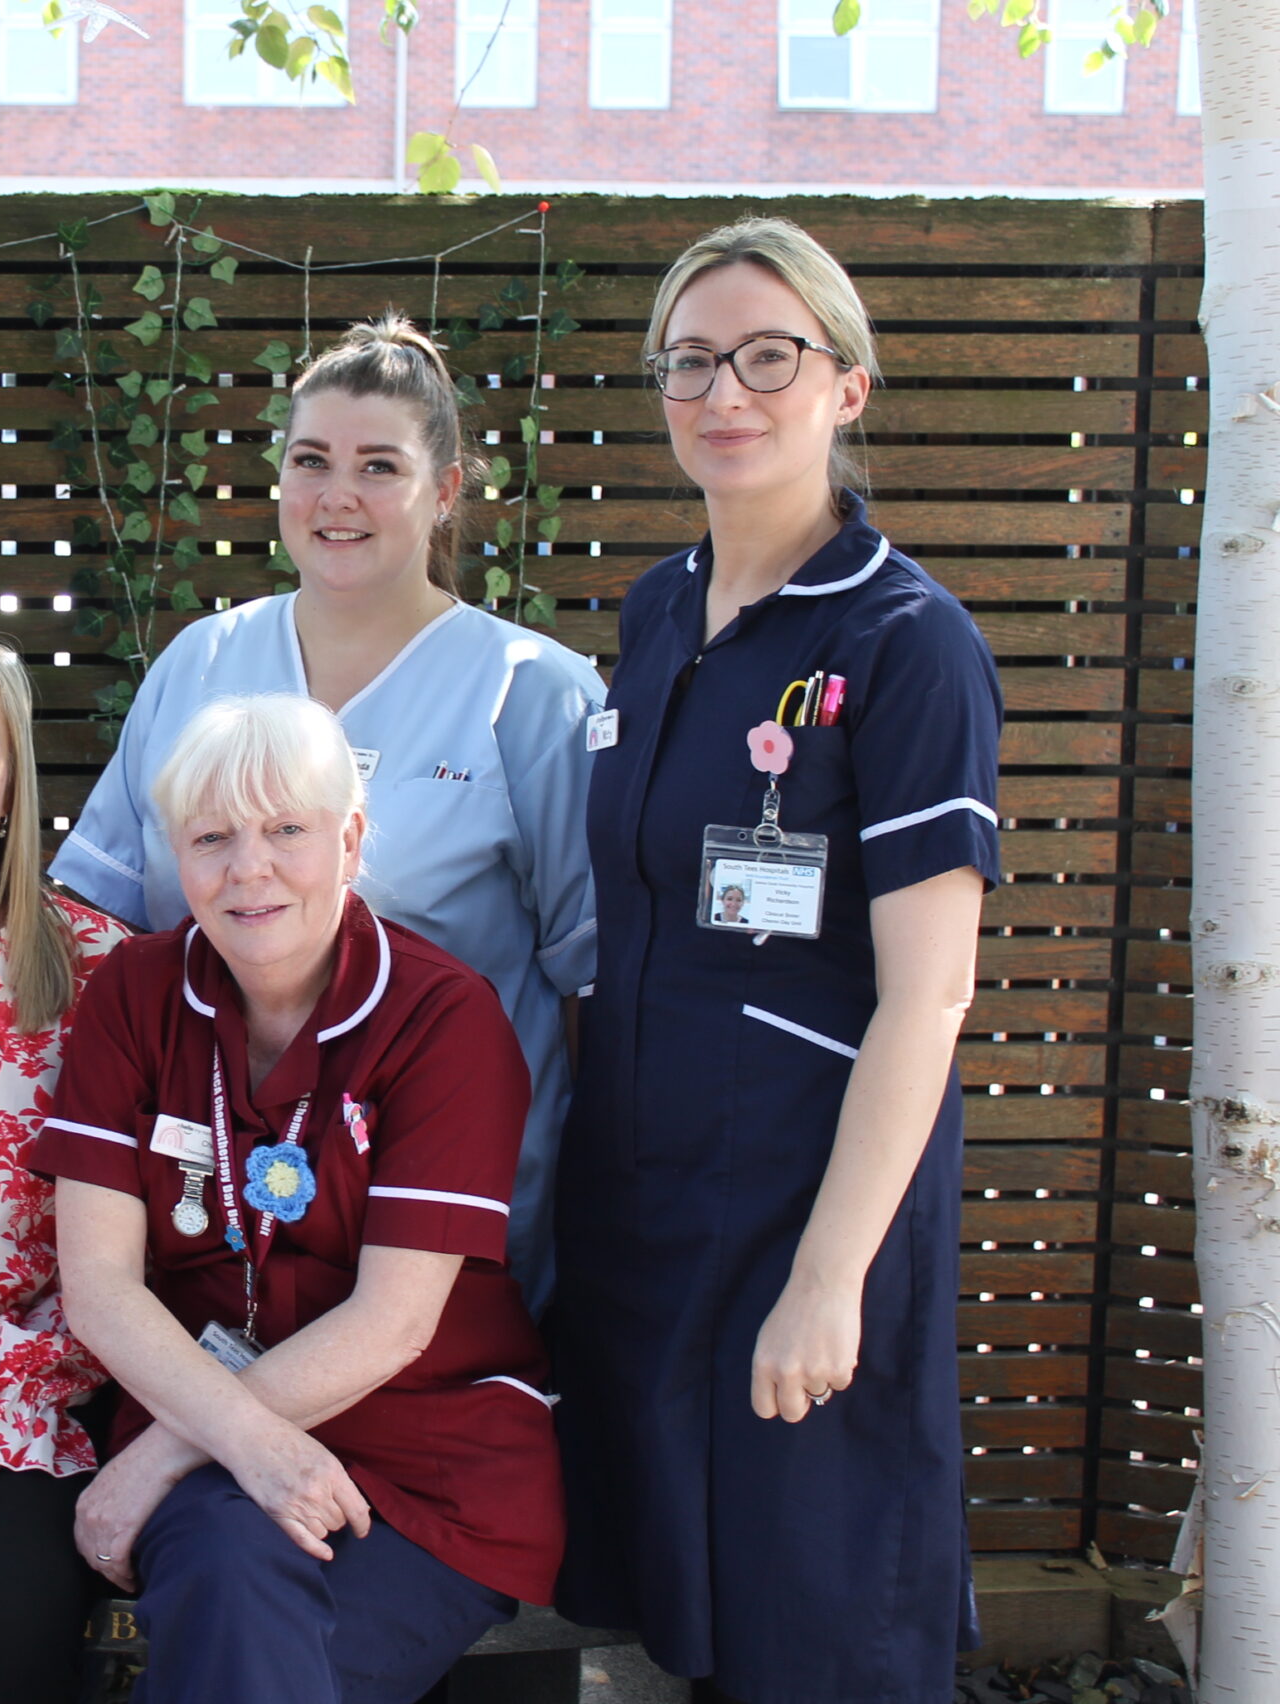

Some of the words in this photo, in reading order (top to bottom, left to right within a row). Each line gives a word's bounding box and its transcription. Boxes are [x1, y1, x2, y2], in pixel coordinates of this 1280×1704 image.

[723, 863, 743, 871] South
[760, 866, 789, 875] Hospitals
[793, 867, 815, 877] NHS
[214, 1095, 231, 1183] Chemotherapy
[222, 1184, 235, 1207] Day
[259, 1210, 275, 1237] Unit
